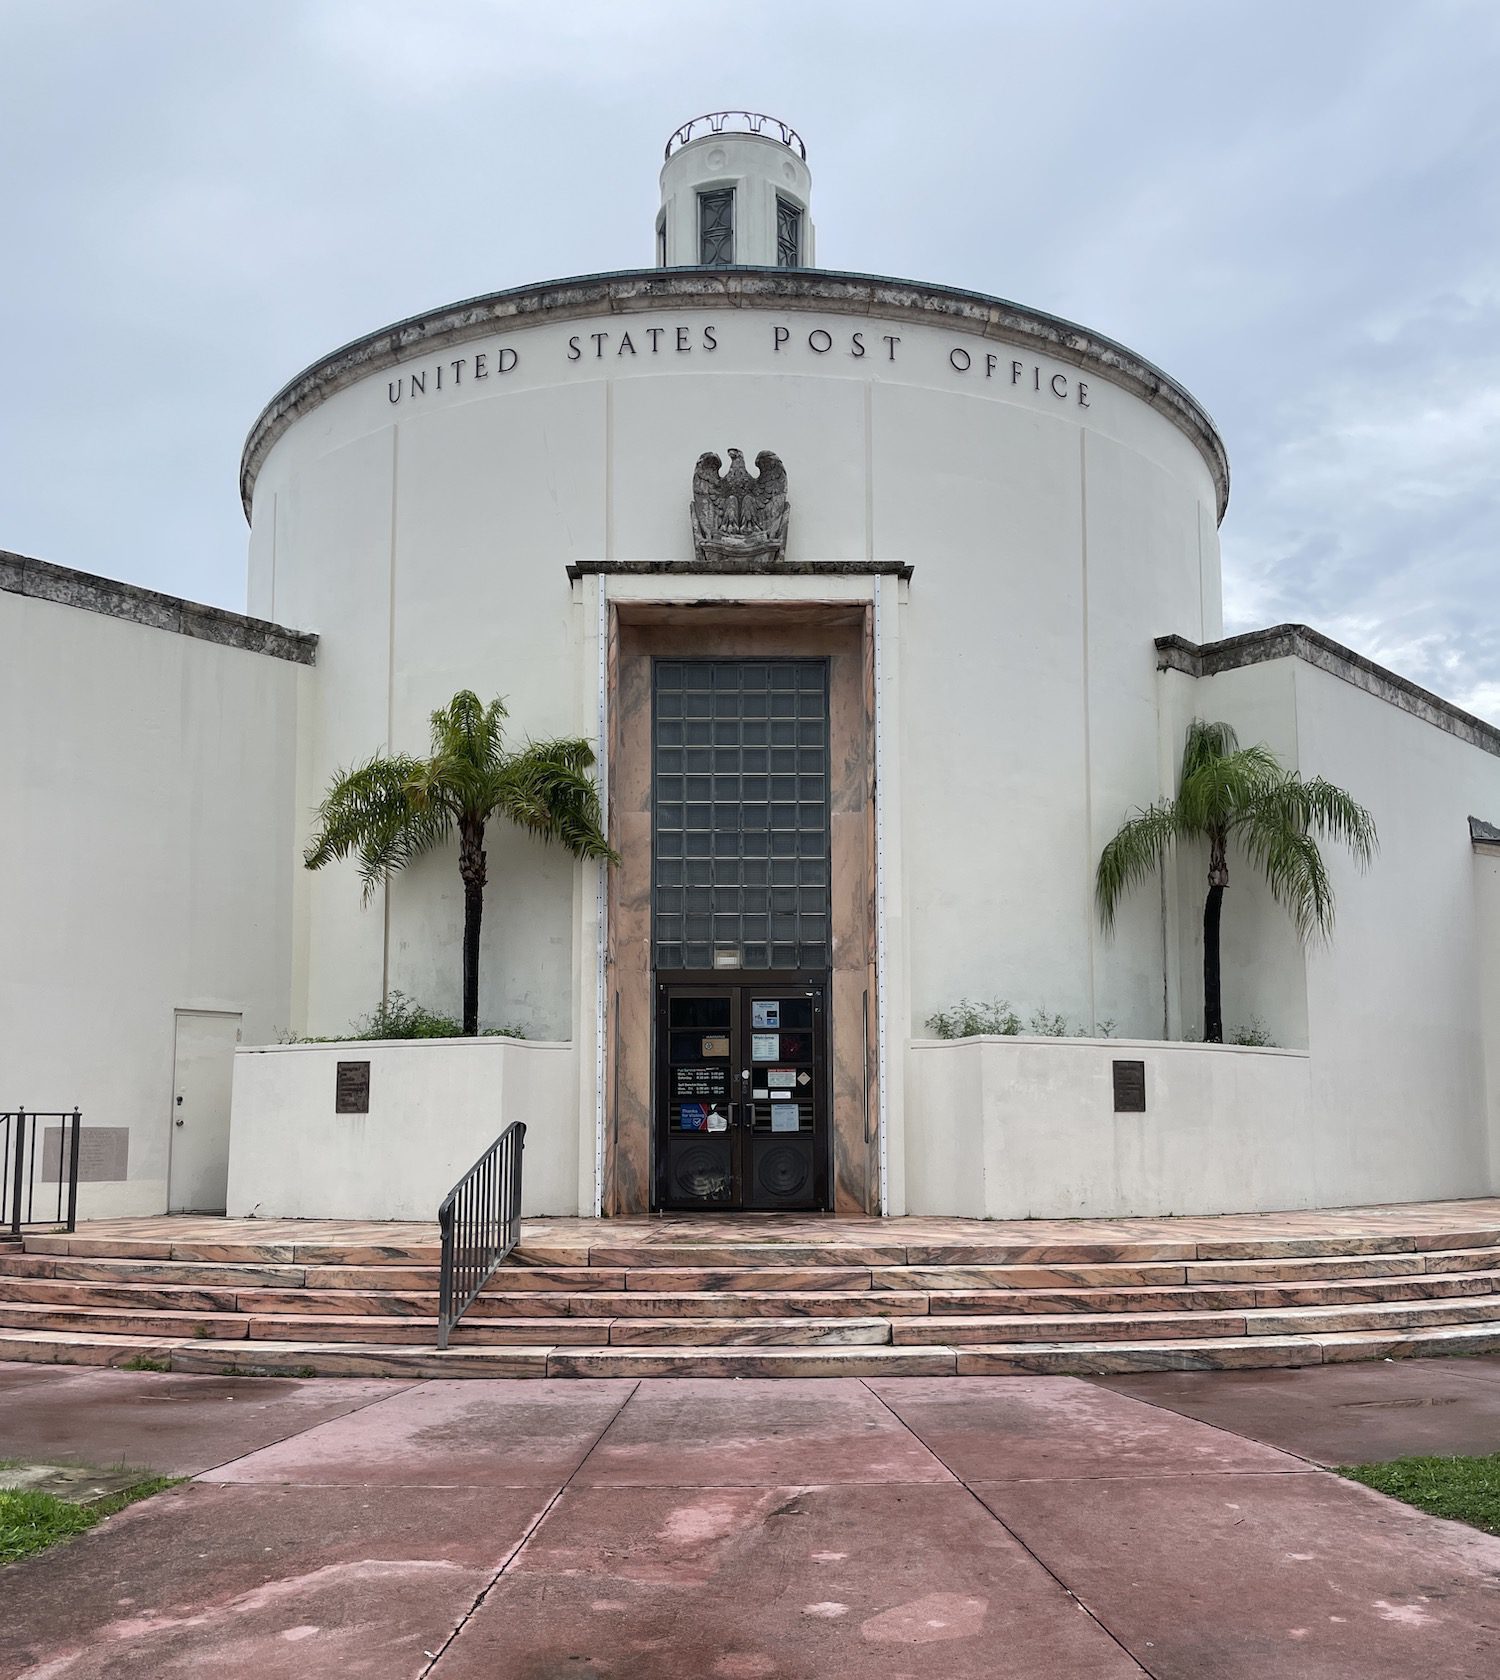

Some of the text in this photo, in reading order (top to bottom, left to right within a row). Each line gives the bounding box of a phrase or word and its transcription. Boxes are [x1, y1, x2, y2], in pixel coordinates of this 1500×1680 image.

[388, 326, 1090, 408] UNITED STATES POST OFFICE
